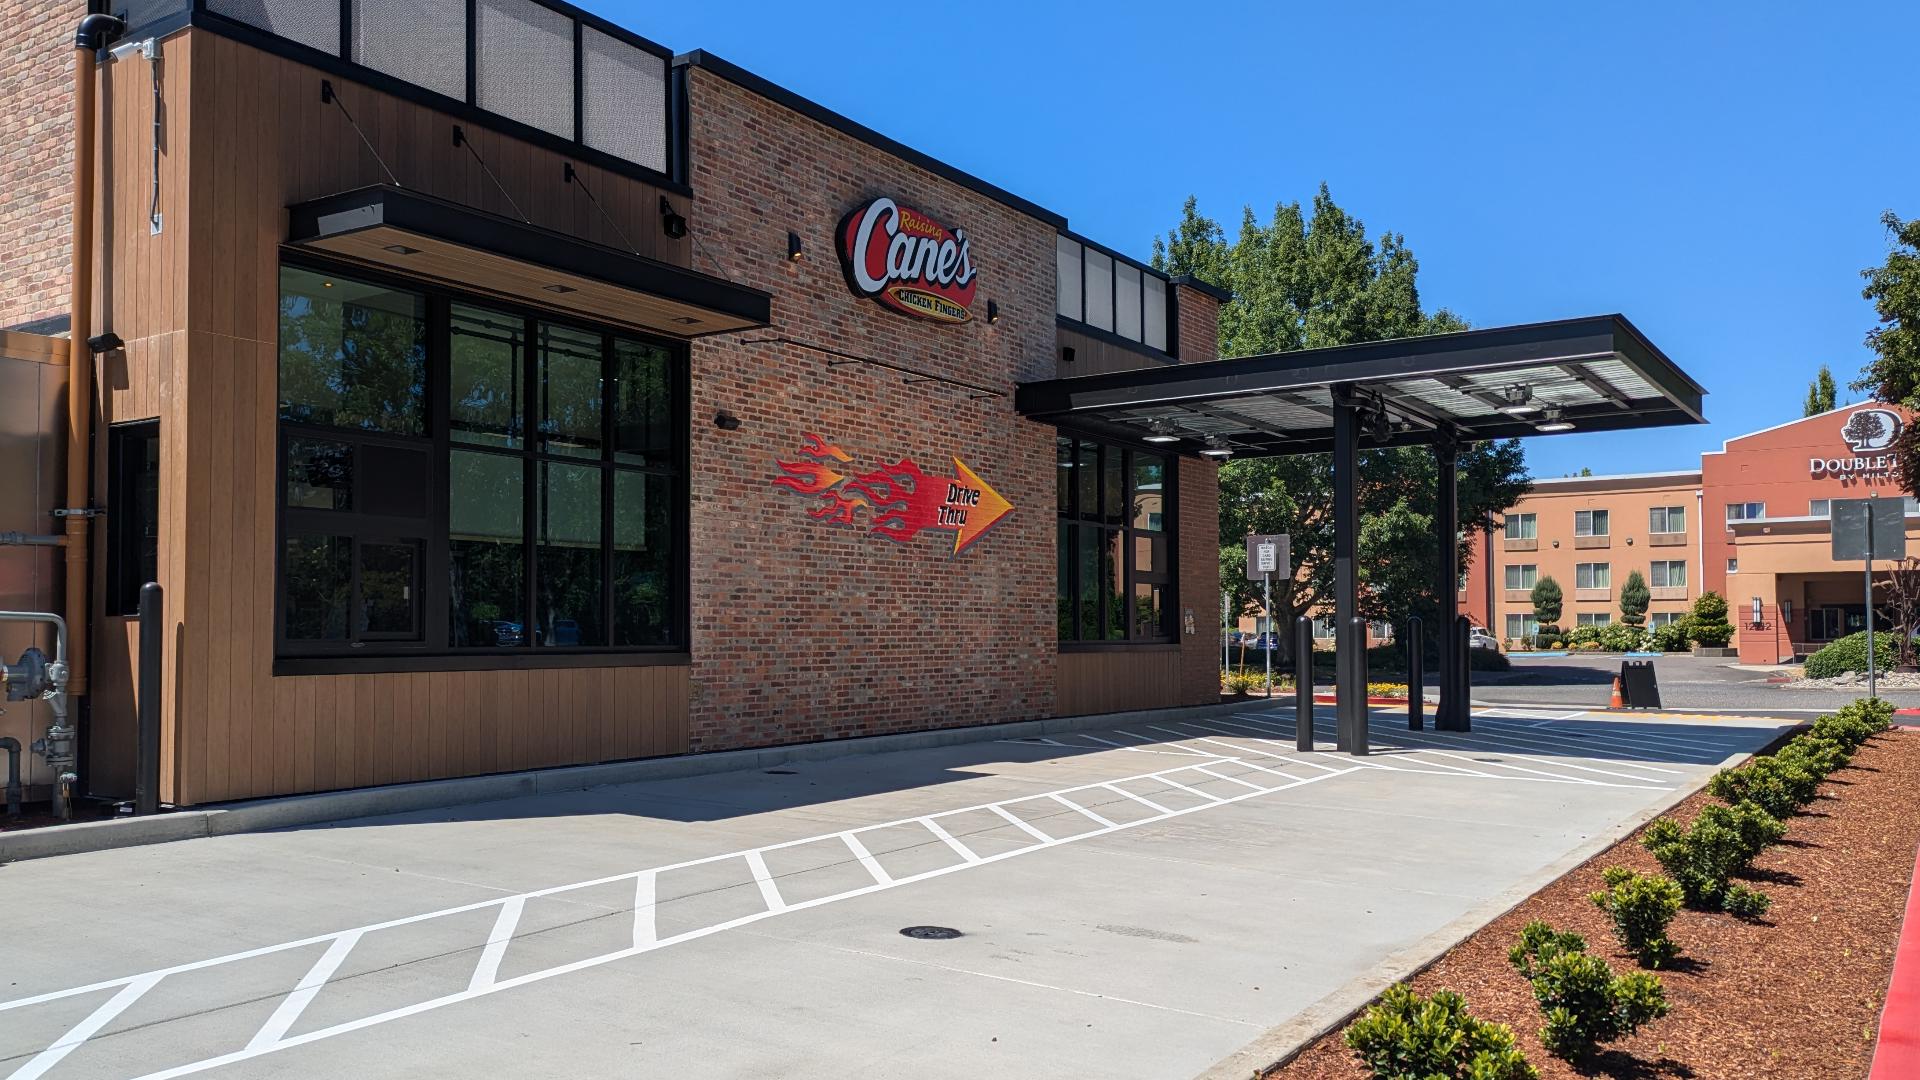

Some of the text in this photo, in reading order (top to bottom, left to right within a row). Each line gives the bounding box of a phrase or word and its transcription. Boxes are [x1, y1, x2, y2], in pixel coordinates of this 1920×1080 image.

[900, 210, 943, 242] Raising
[853, 197, 977, 293] Cane's
[899, 289, 966, 320] CHICKEN FINGERS
[1810, 453, 1899, 473] DOUBLET
[1862, 471, 1903, 479] HILTO
[945, 483, 981, 507] Drive
[937, 505, 968, 527] Thru
